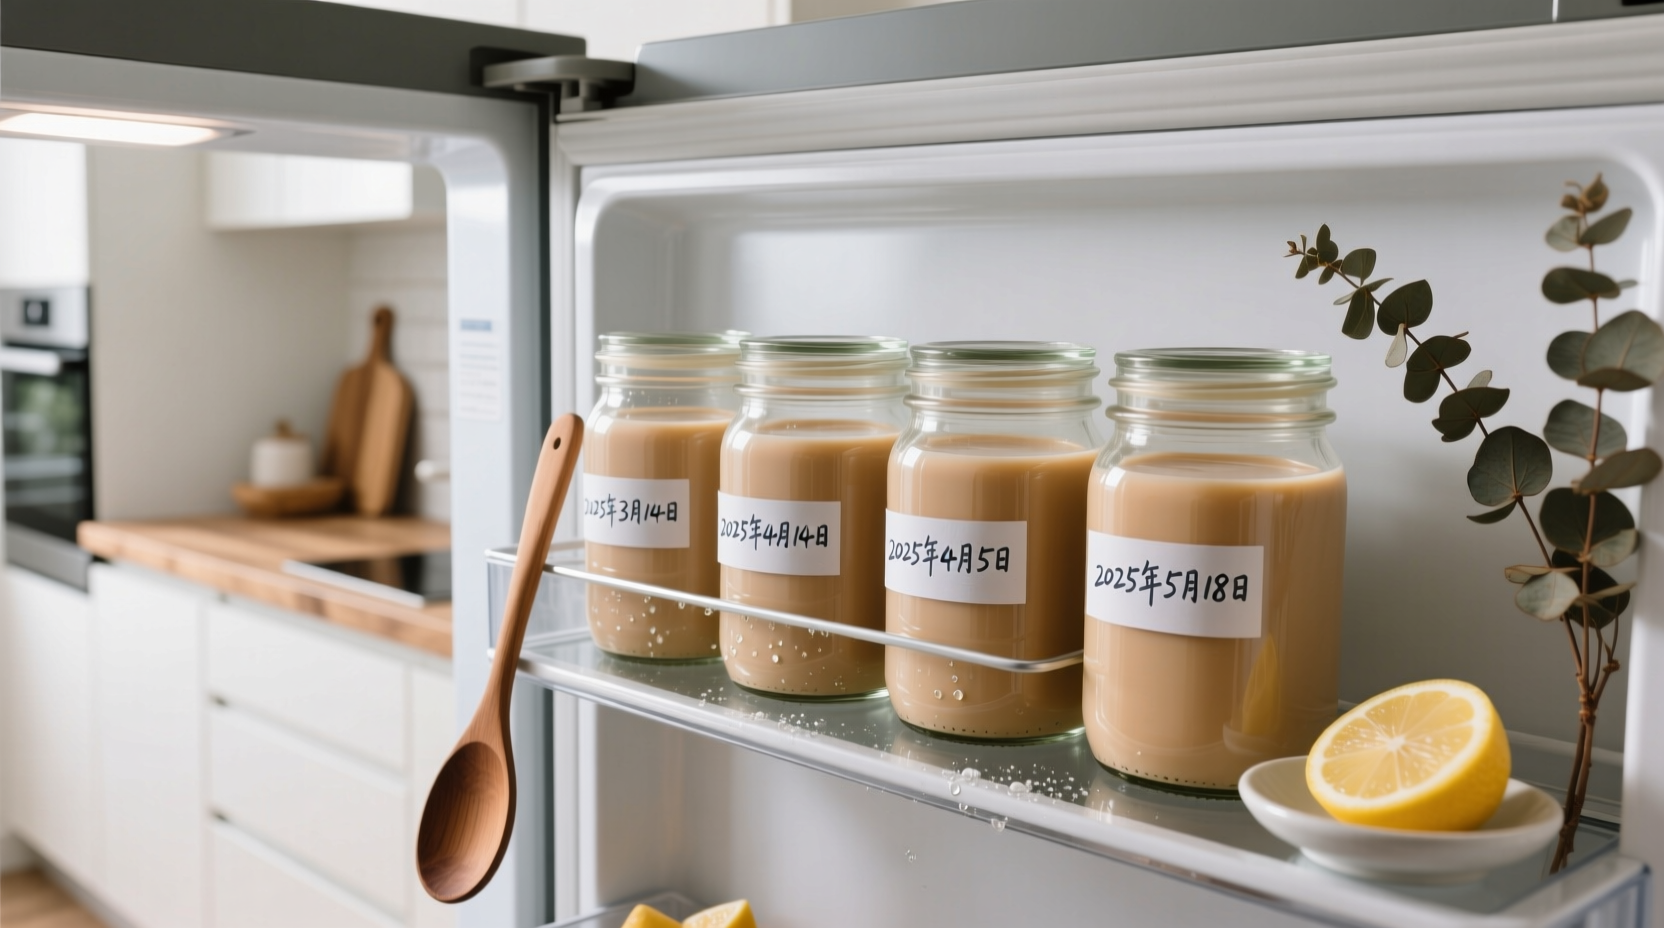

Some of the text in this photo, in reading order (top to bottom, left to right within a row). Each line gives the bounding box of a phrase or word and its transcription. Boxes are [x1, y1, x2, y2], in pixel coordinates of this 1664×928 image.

[720, 513, 828, 550] 2025年4月14日
[888, 535, 1010, 577] 2025年4月5日
[1094, 560, 1249, 607] 2025年5月18日
